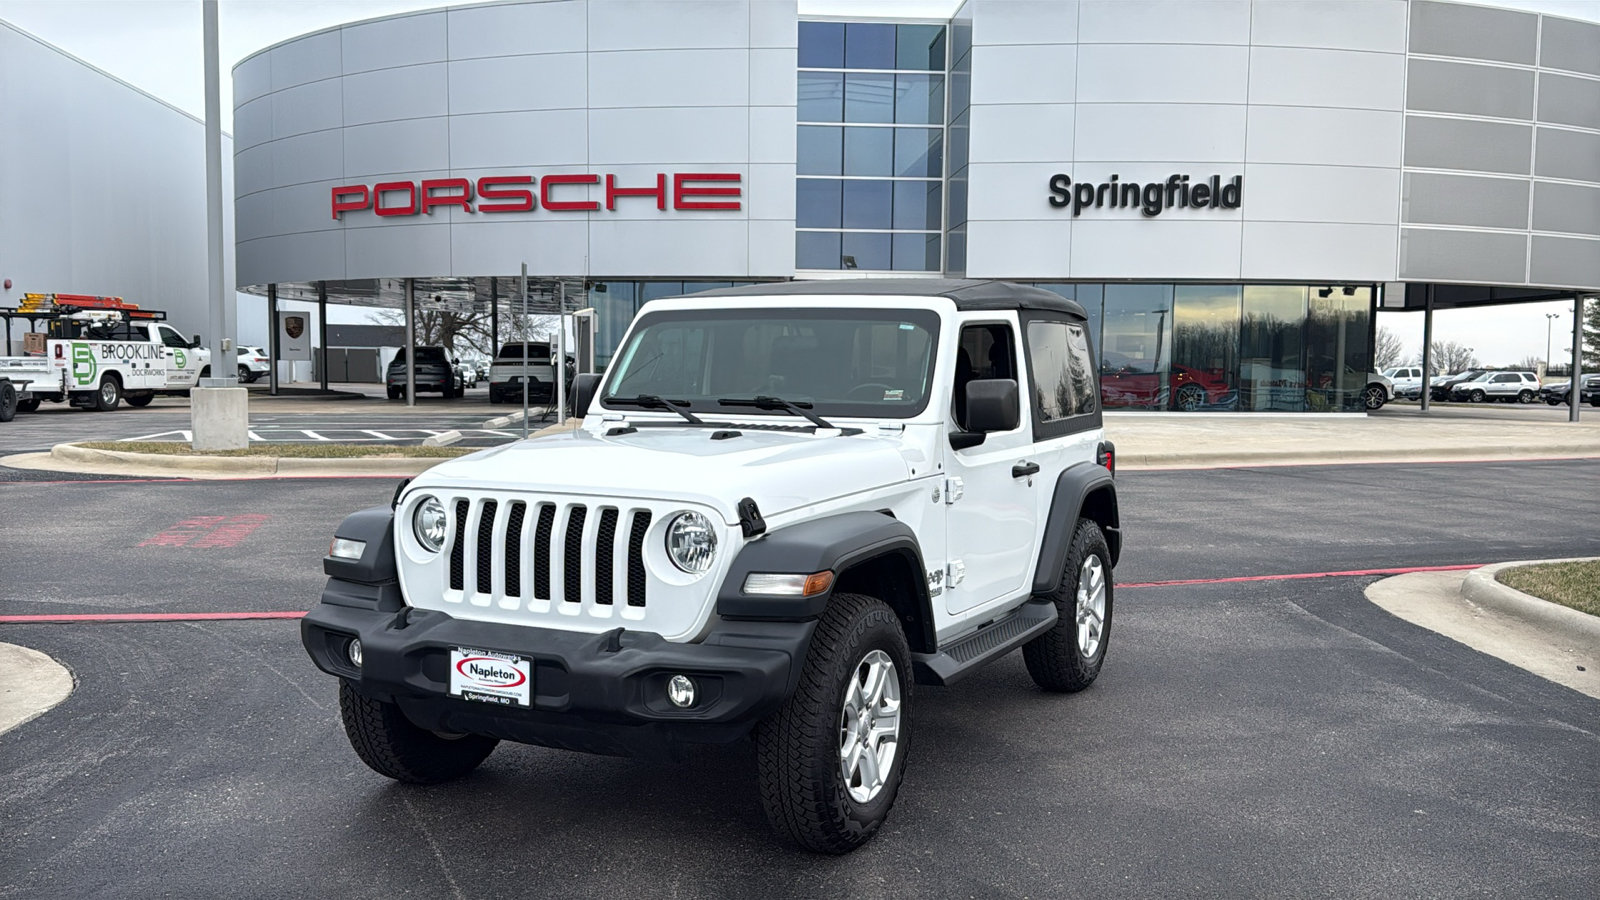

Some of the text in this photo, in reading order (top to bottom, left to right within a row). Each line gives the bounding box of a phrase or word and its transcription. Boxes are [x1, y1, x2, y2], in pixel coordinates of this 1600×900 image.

[332, 173, 741, 220] PORSCHE
[1048, 174, 1243, 216] Springfield
[101, 343, 165, 360] BROOKLINE
[458, 646, 486, 656] Napleton
[470, 662, 515, 680] Napleton
